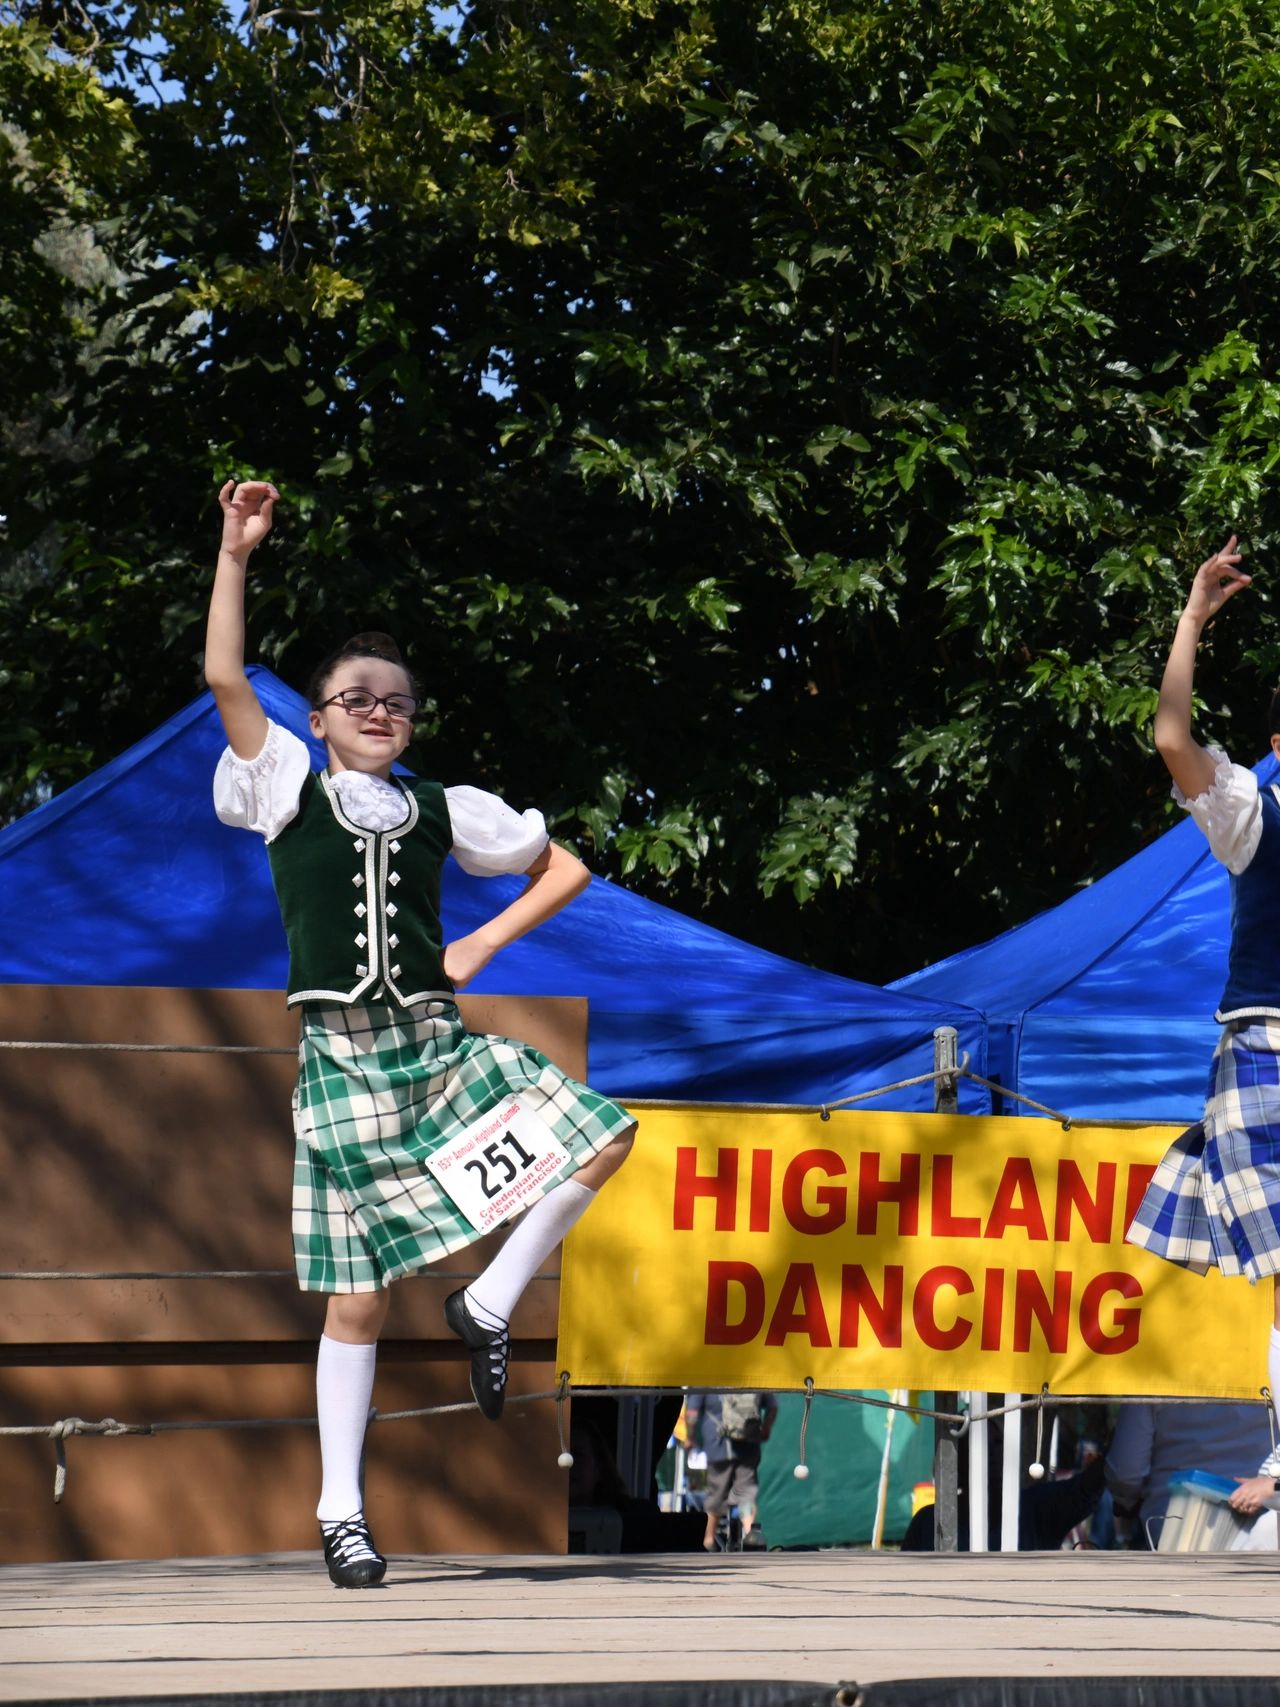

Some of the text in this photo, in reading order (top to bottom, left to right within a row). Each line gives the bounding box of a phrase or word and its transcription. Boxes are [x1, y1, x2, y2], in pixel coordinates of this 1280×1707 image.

[452, 1139, 475, 1160] Annual
[473, 1118, 502, 1144] Highland
[499, 1103, 520, 1123] Games
[463, 1130, 537, 1199] 251
[479, 1151, 556, 1218] Caledonian Club
[484, 1156, 562, 1226] of San Francisco
[704, 1260, 1144, 1355] DANCING
